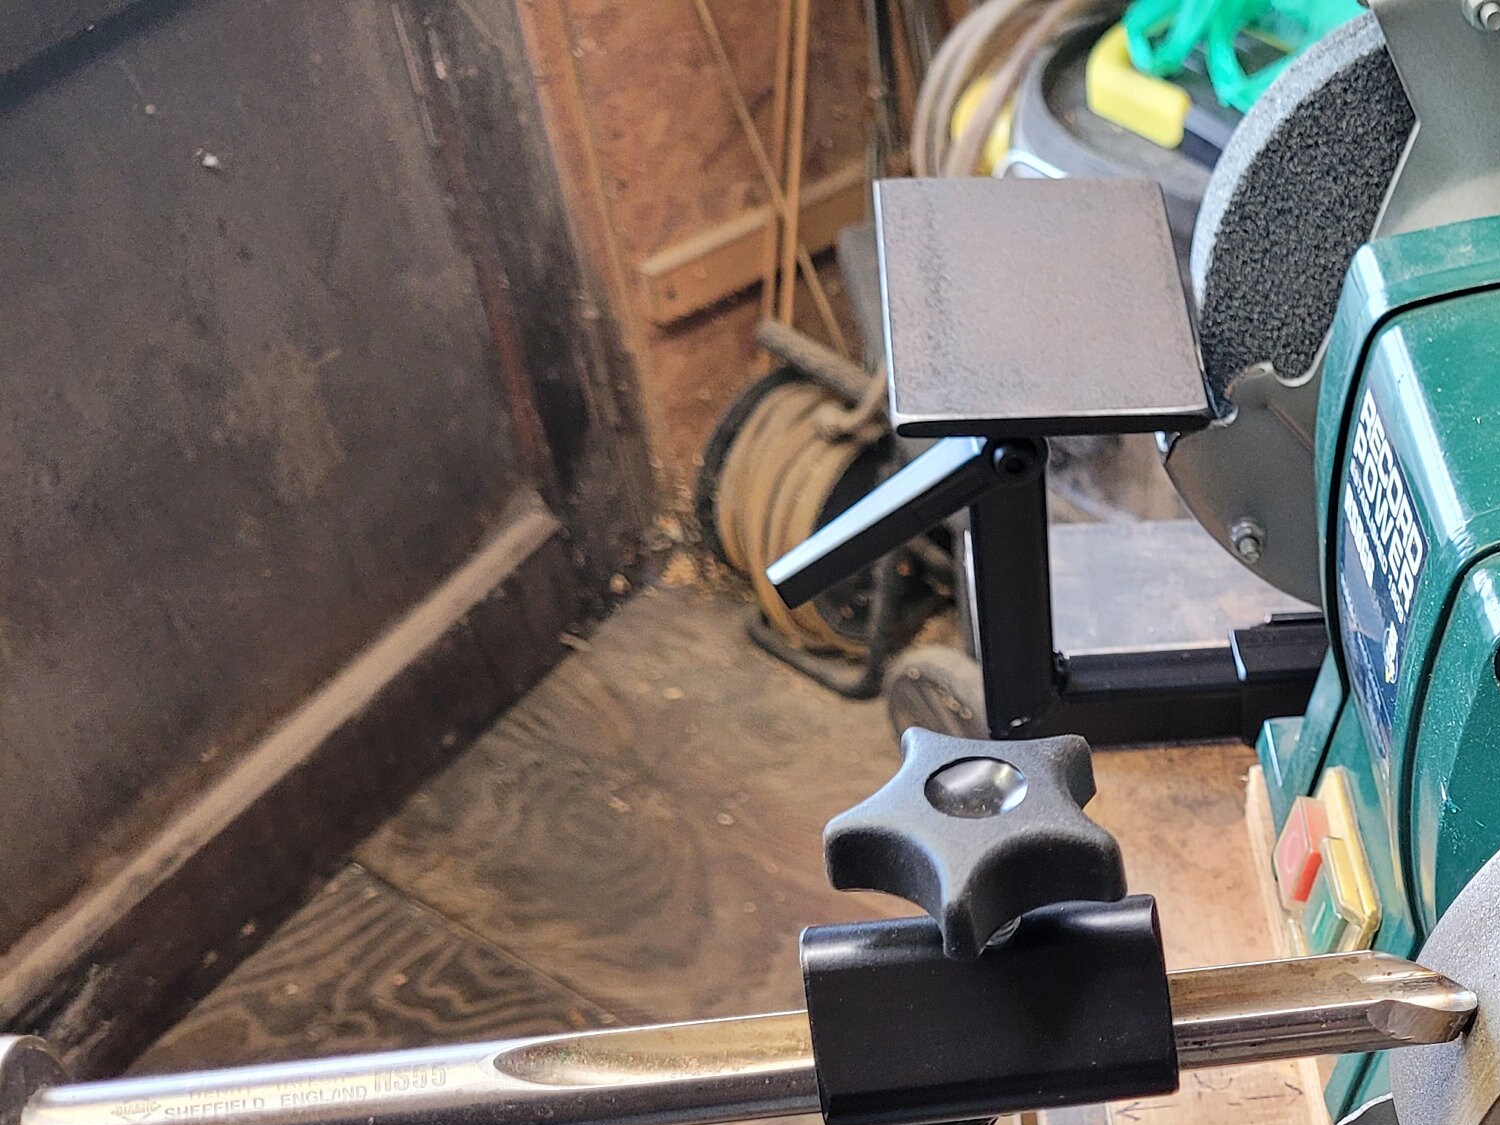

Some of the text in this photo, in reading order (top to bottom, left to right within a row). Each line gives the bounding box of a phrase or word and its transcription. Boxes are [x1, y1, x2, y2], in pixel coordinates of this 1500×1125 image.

[1352, 421, 1415, 614] POWER
[1360, 387, 1423, 577] RECORD
[164, 1085, 368, 1121] SHEFFIELD ENGLAND
